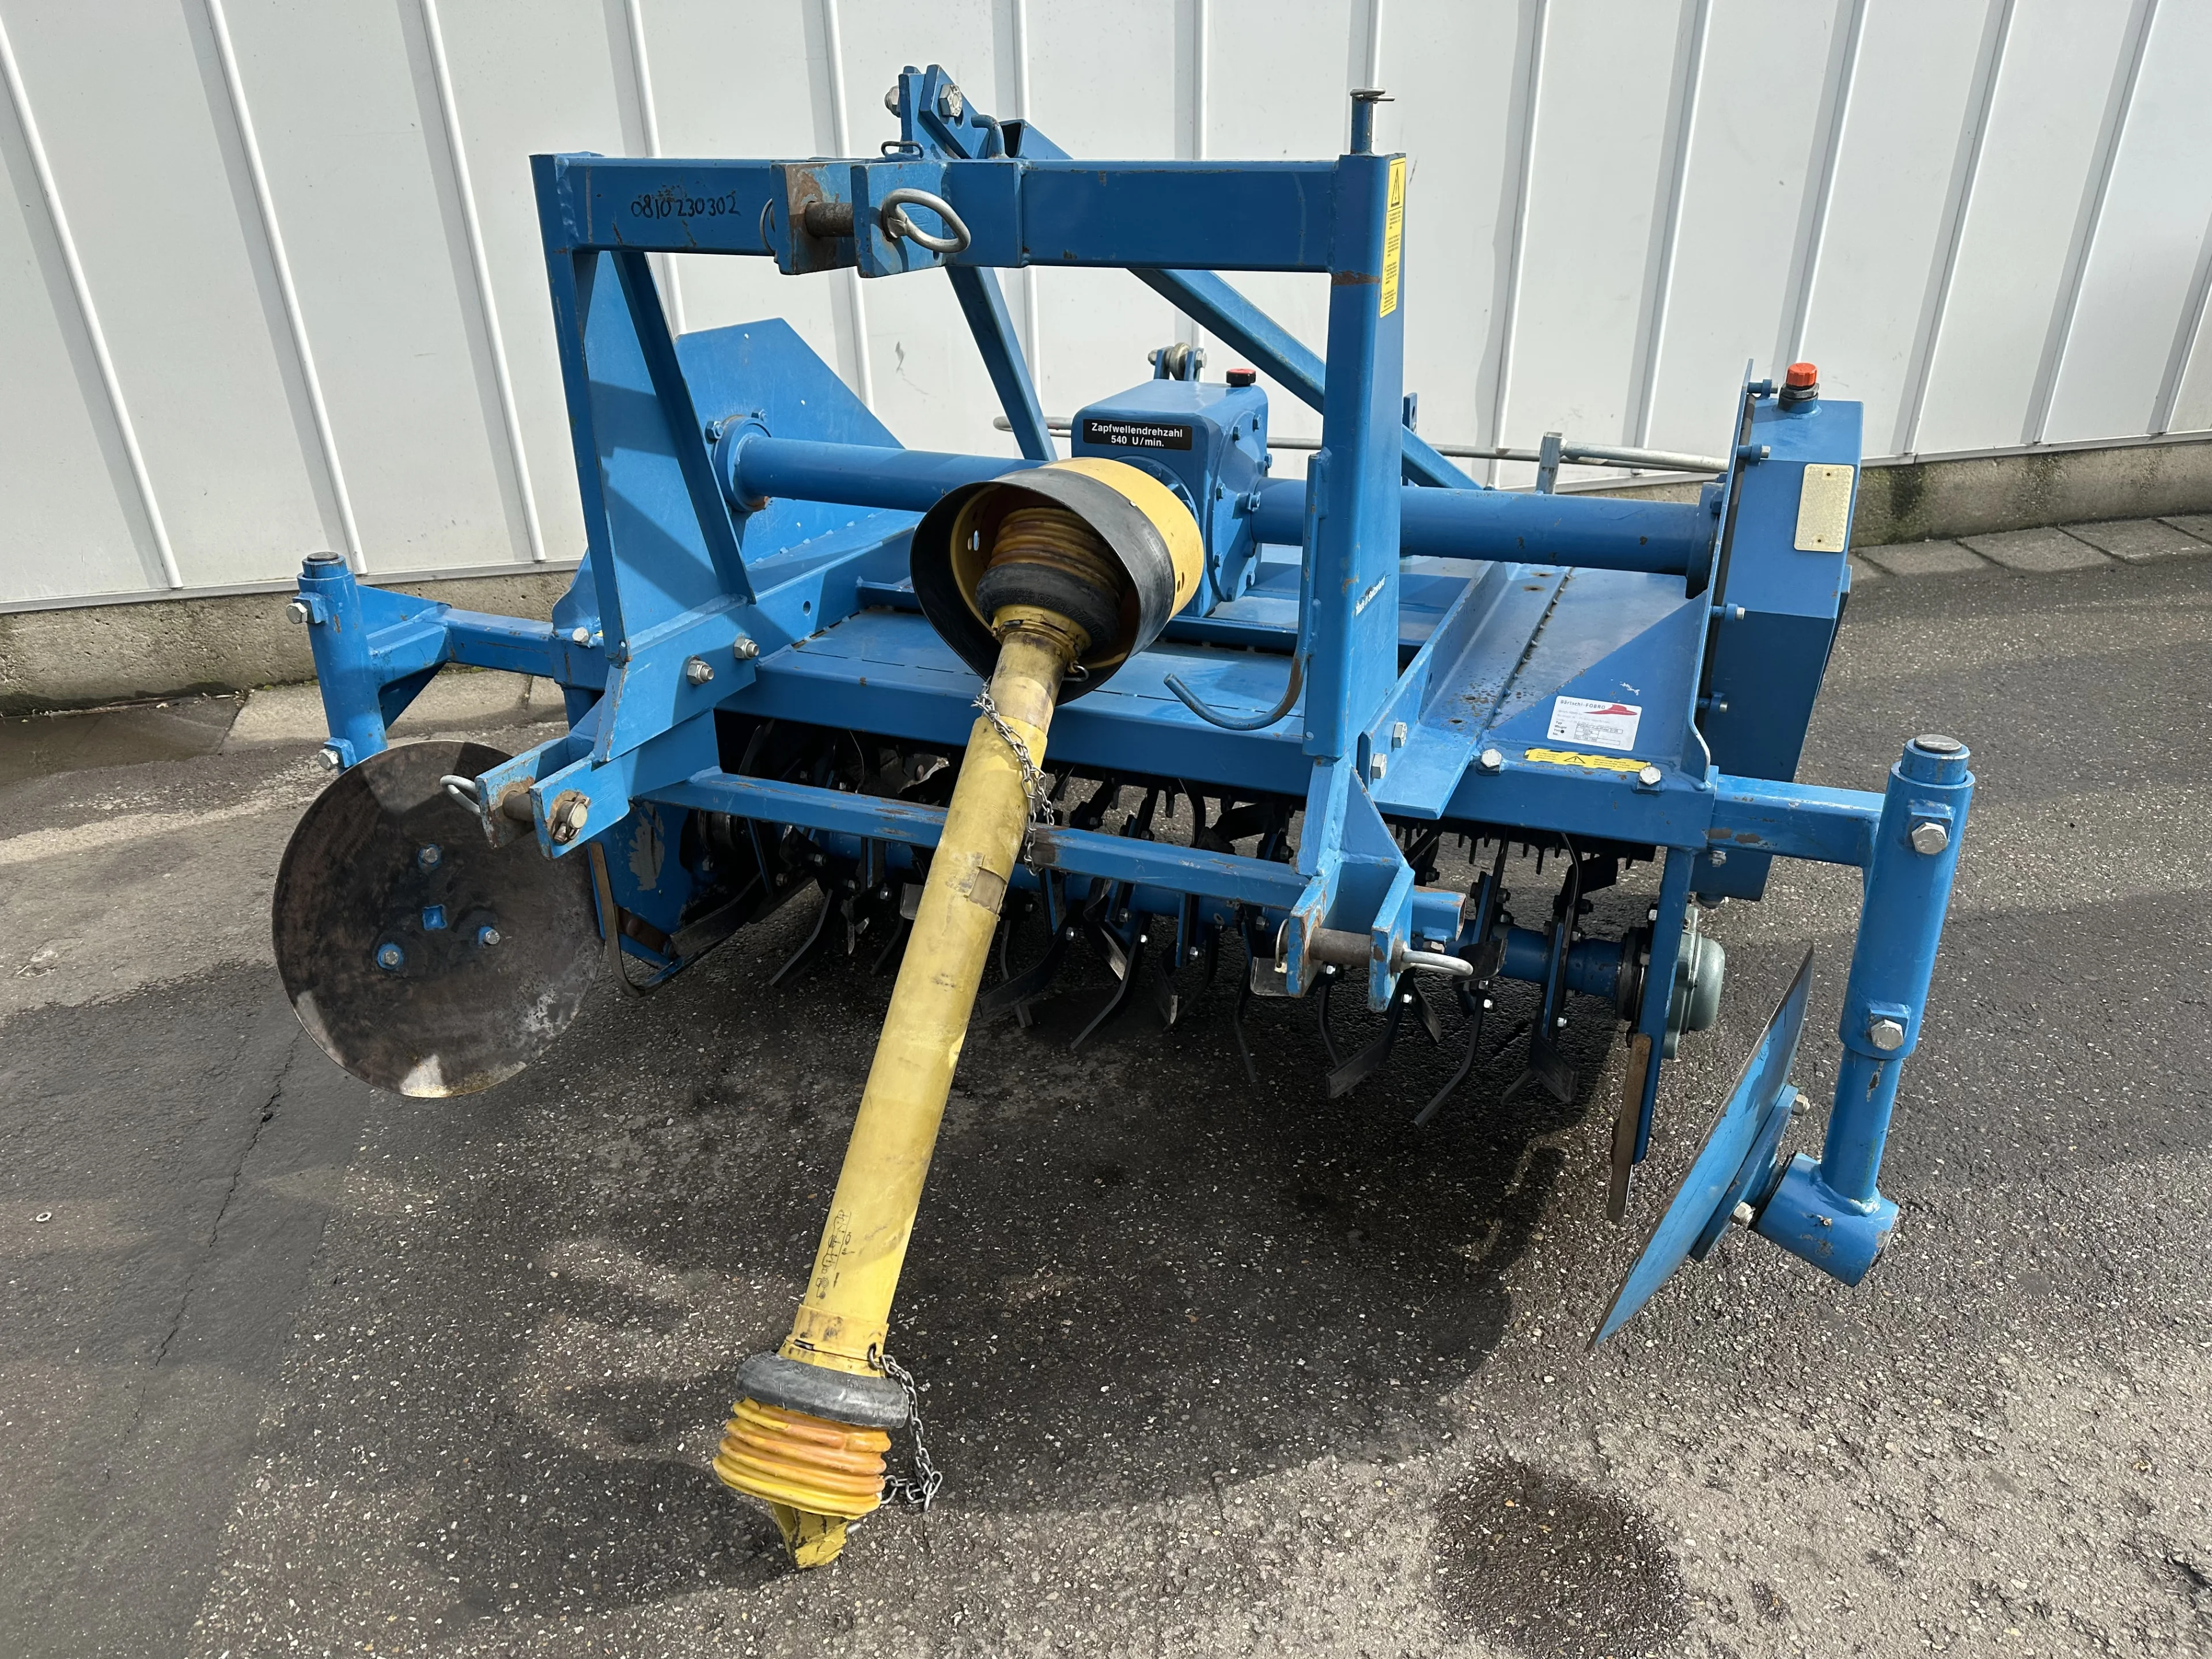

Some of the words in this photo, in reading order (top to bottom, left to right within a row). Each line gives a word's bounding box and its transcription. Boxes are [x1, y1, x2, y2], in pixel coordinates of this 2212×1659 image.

[1092, 423, 1183, 438] Zapfwellendrehzahl
[1111, 435, 1127, 444] 540
[1132, 437, 1164, 447] U/min.
